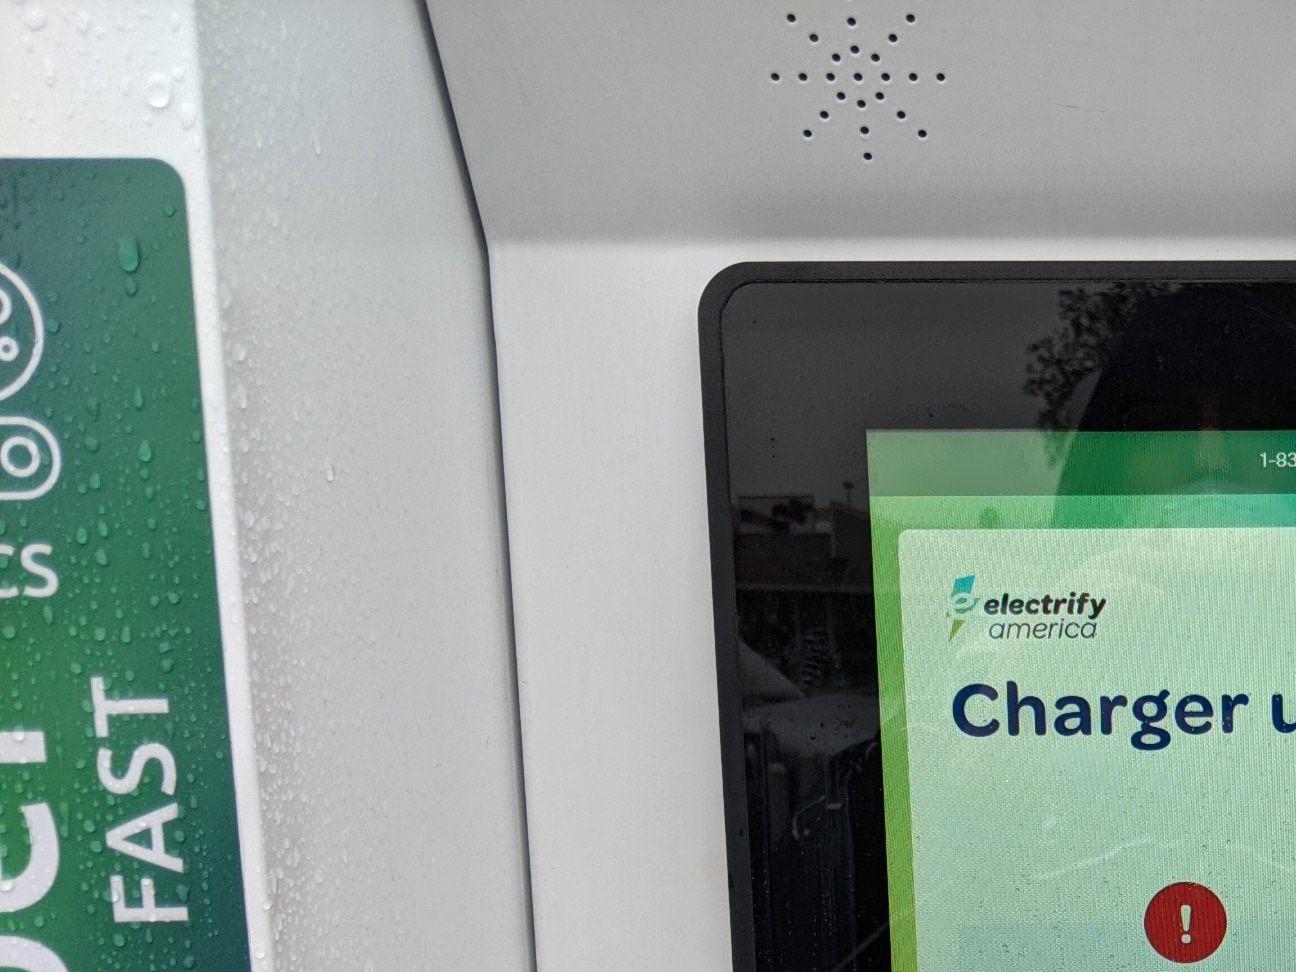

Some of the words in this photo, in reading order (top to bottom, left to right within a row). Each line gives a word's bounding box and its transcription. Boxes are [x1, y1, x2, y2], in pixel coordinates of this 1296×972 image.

[983, 591, 1107, 620] electrify
[989, 618, 1097, 639] america
[951, 680, 1248, 750] Charger
[91, 676, 188, 923] FAST
